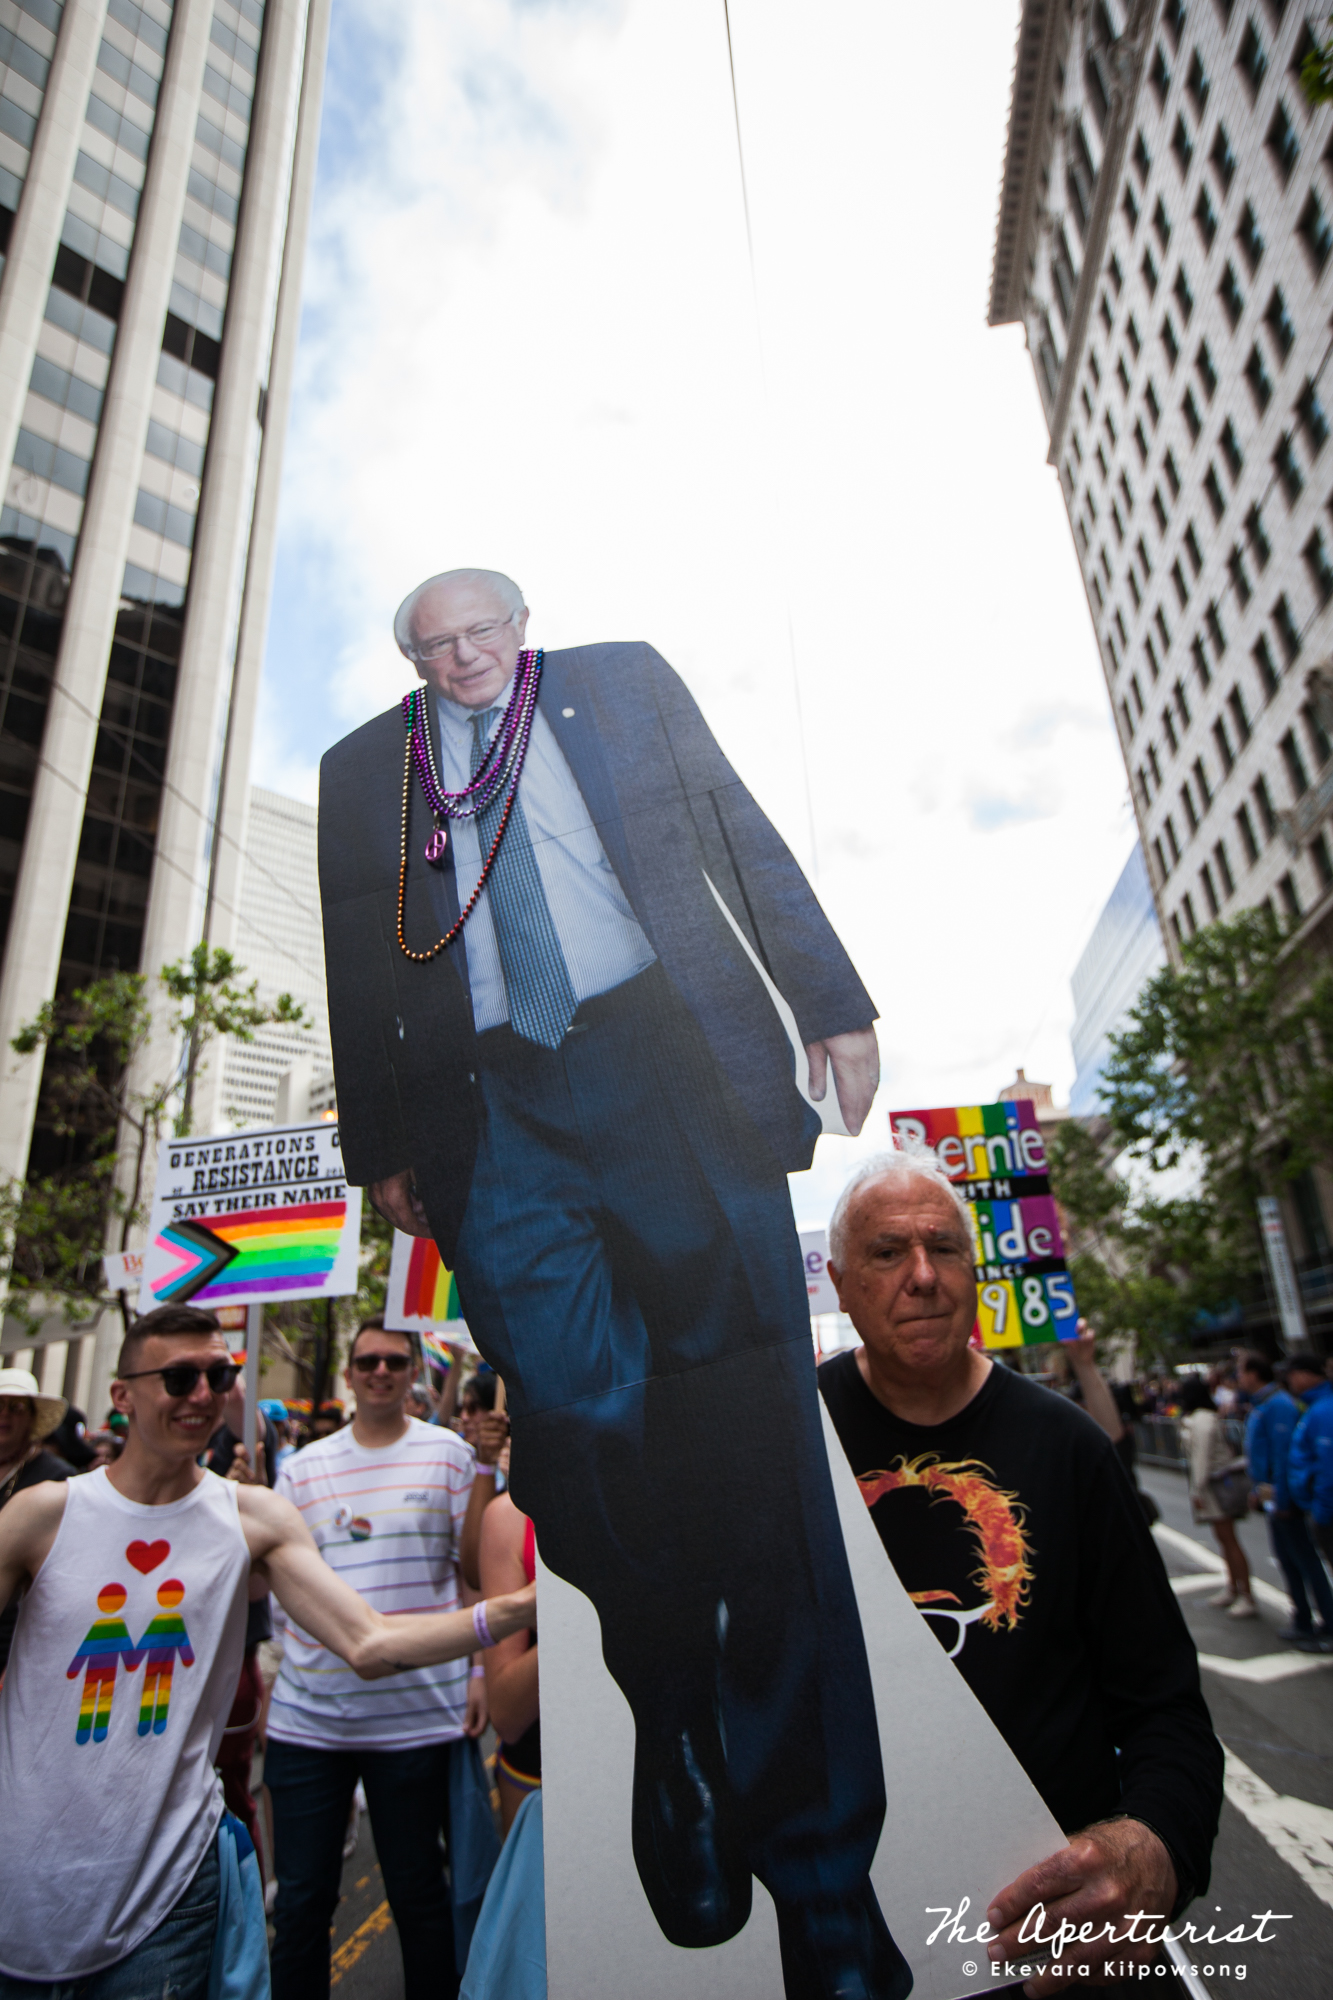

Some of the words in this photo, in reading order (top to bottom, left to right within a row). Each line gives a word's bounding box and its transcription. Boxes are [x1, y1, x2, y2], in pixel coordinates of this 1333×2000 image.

[170, 1136, 315, 1168] GENERATIONS
[192, 1155, 319, 1191] RESISTANCE
[173, 1200, 209, 1219] SAY
[214, 1192, 277, 1213] THEIR
[283, 1184, 346, 1205] NAME
[979, 1202, 1052, 1261] ide
[976, 1264, 1024, 1282] INCE
[981, 1275, 1076, 1333] 985
